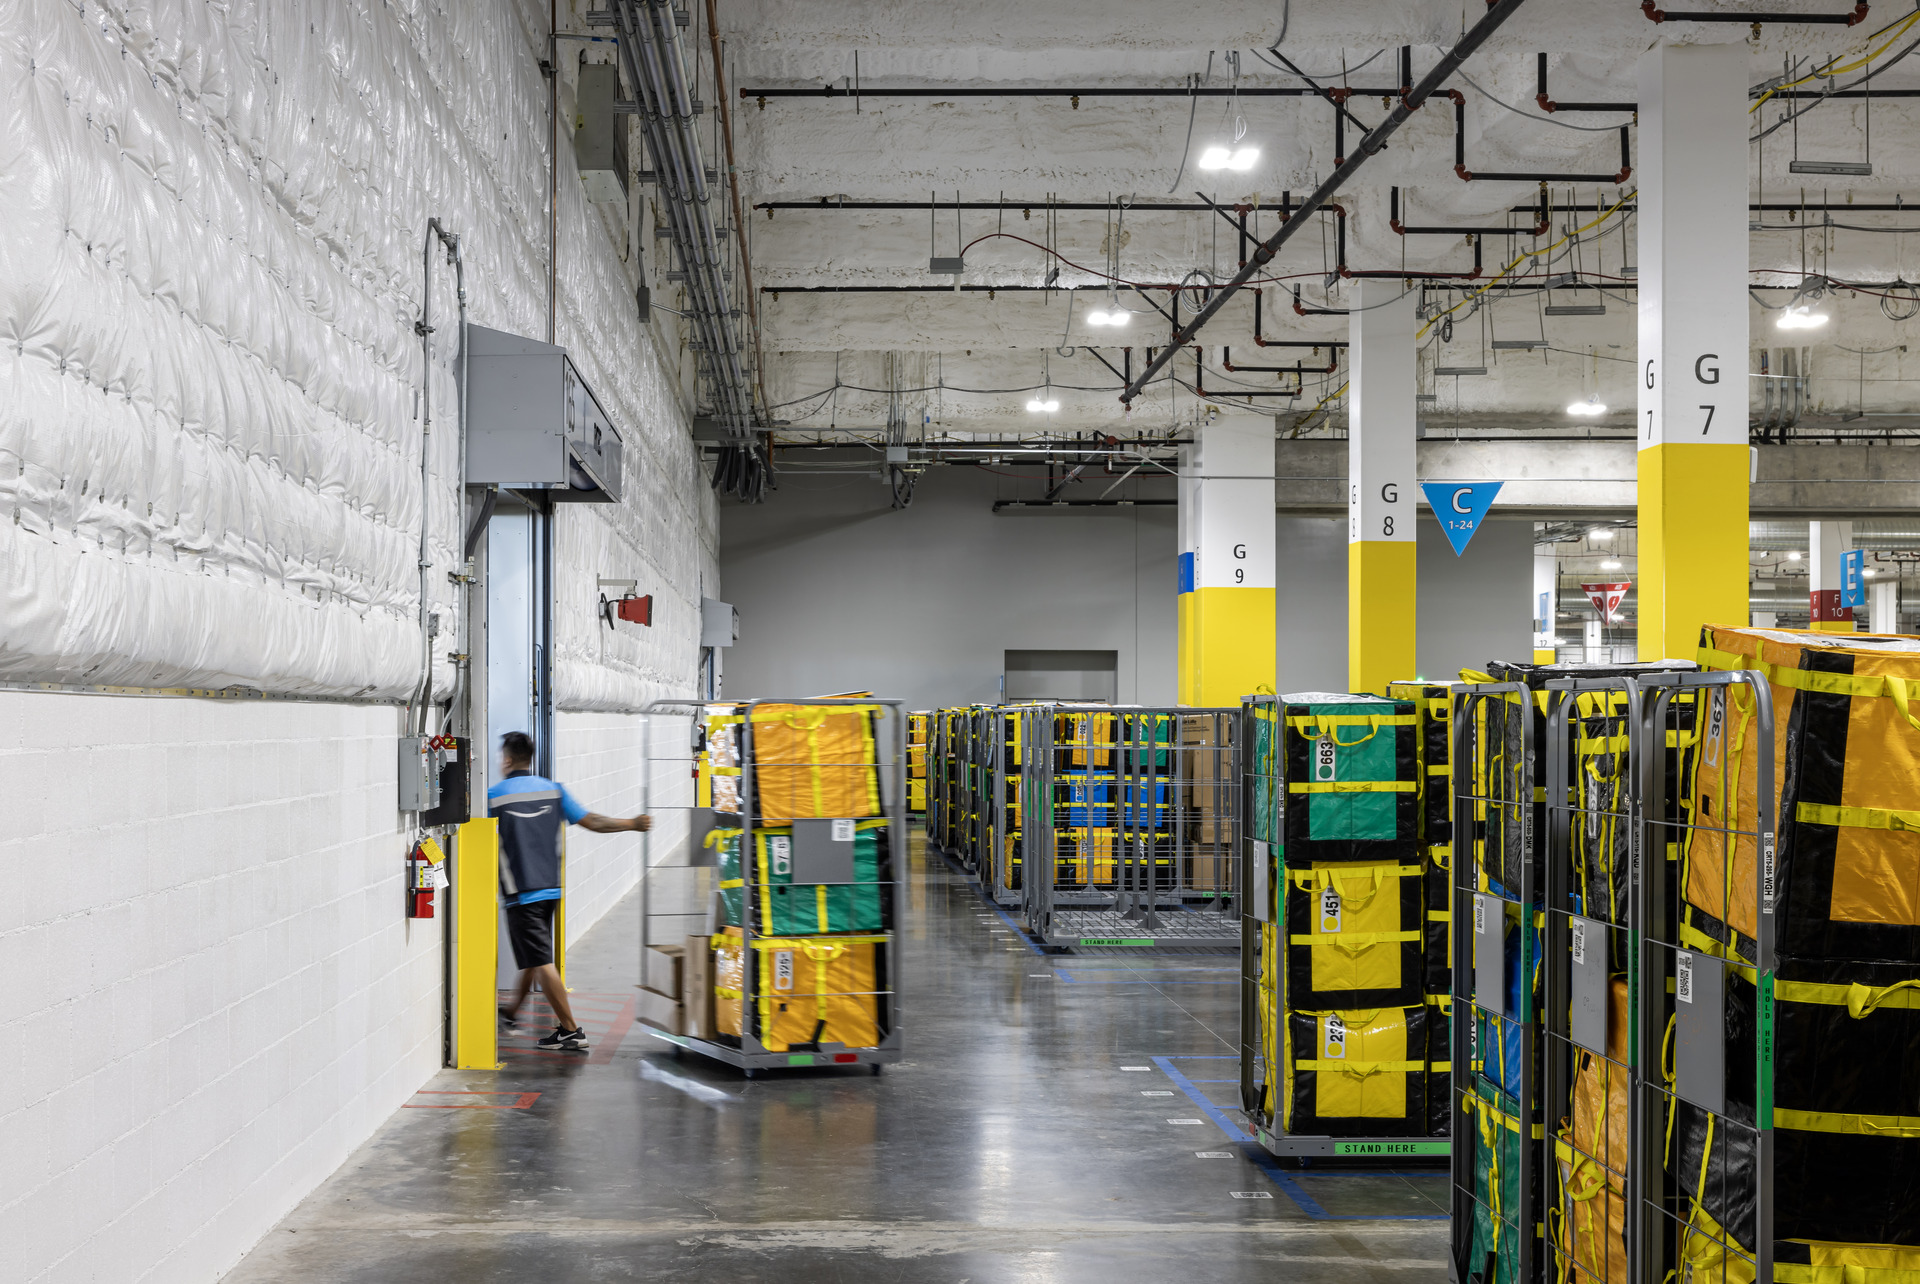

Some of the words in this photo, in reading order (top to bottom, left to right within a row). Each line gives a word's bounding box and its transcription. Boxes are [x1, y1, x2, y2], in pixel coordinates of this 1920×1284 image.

[1645, 359, 1655, 390] G
[1694, 353, 1720, 385] G
[1647, 410, 1653, 441] 7
[1699, 405, 1715, 436] 7
[1381, 483, 1398, 503] G
[1452, 487, 1473, 514] C
[1383, 516, 1394, 536] 8
[1448, 520, 1474, 530] 1-24
[1233, 544, 1247, 559] G
[1235, 568, 1244, 584] 9
[1846, 552, 1857, 591] E
[1813, 595, 1817, 605] F
[1834, 594, 1840, 604] F
[1831, 608, 1844, 617] 10
[1711, 694, 1723, 737] 367
[1320, 742, 1334, 765] 663
[1325, 895, 1339, 917] 451
[1330, 1019, 1343, 1043] 232
[1344, 1144, 1382, 1153] STAND
[1386, 1144, 1417, 1153] HERE
